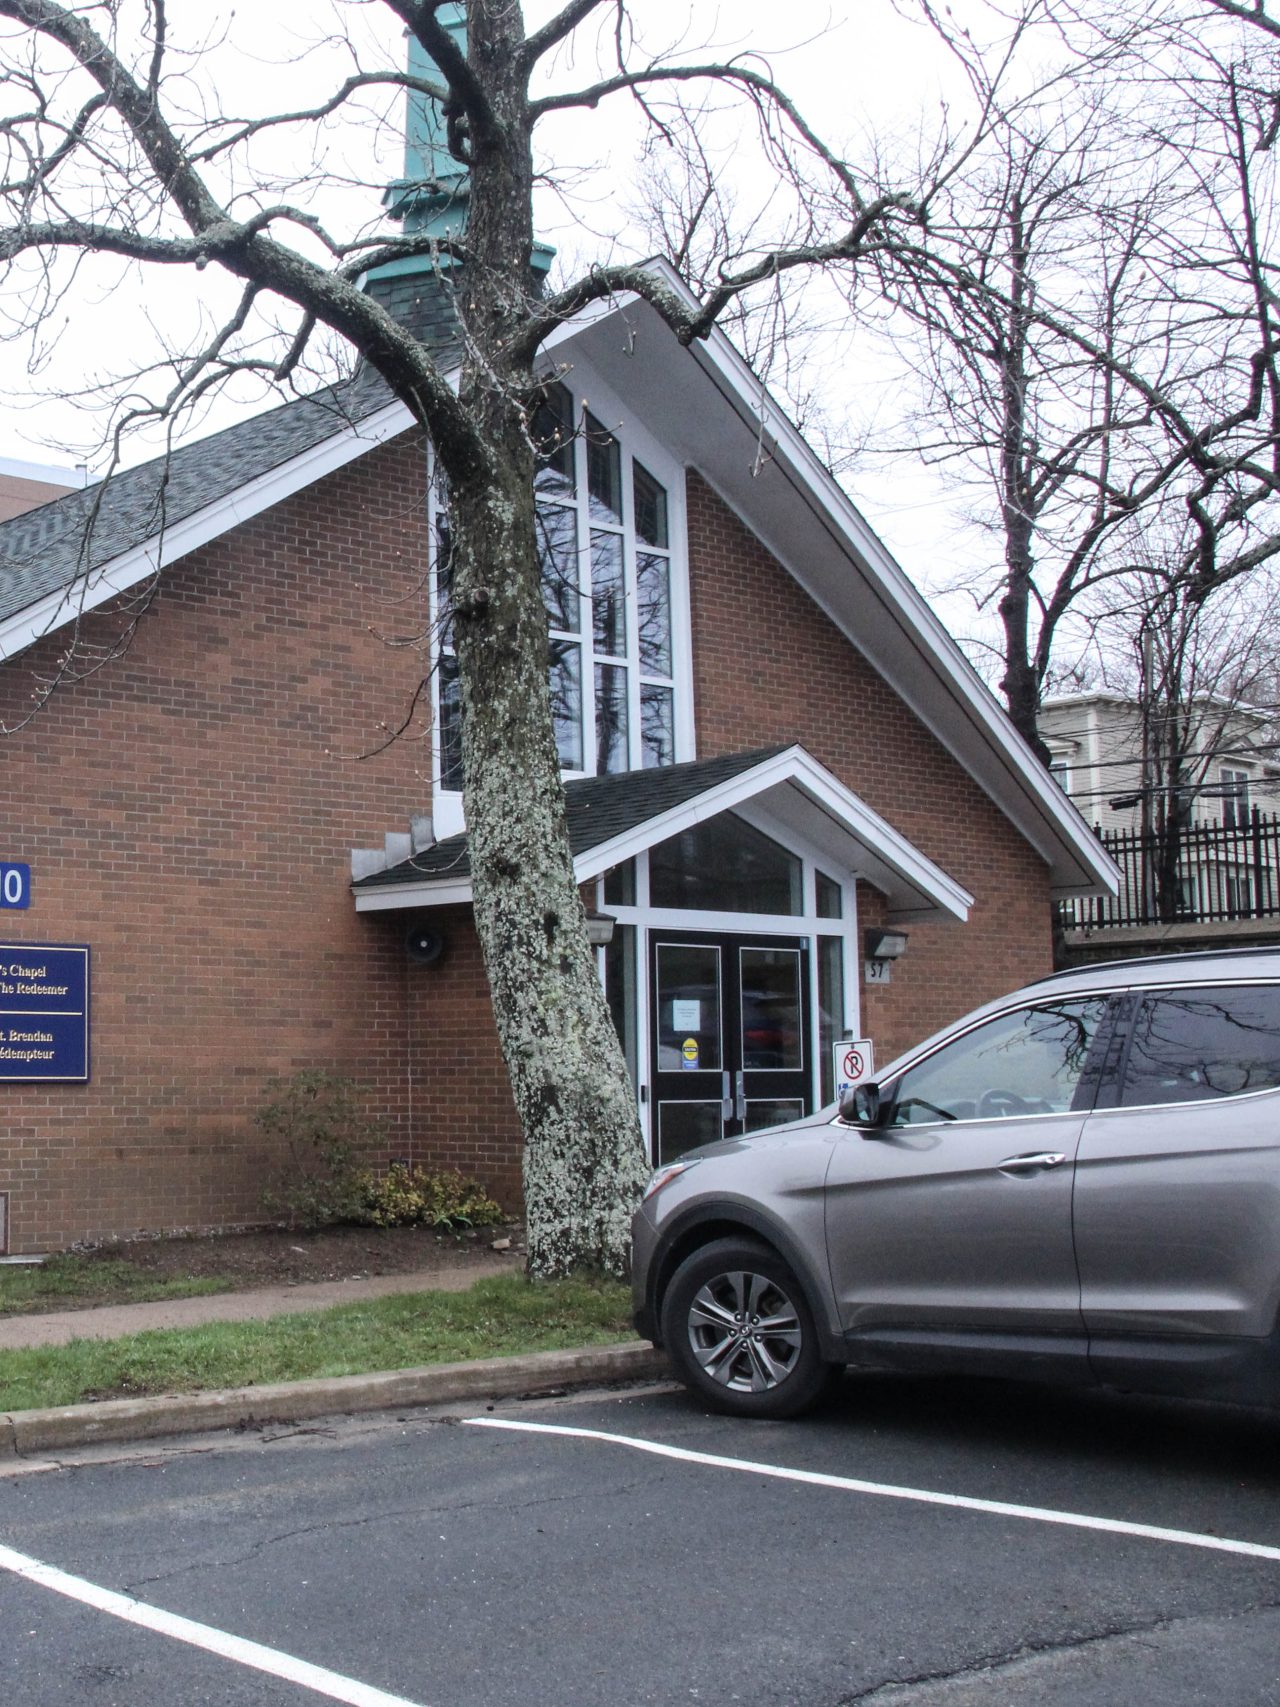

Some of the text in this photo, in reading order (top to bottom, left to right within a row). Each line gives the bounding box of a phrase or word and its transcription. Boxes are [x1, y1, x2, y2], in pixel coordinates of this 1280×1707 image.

[10, 964, 46, 980] Chapel
[16, 982, 68, 995] Redeemer
[9, 1030, 53, 1042] Brendan
